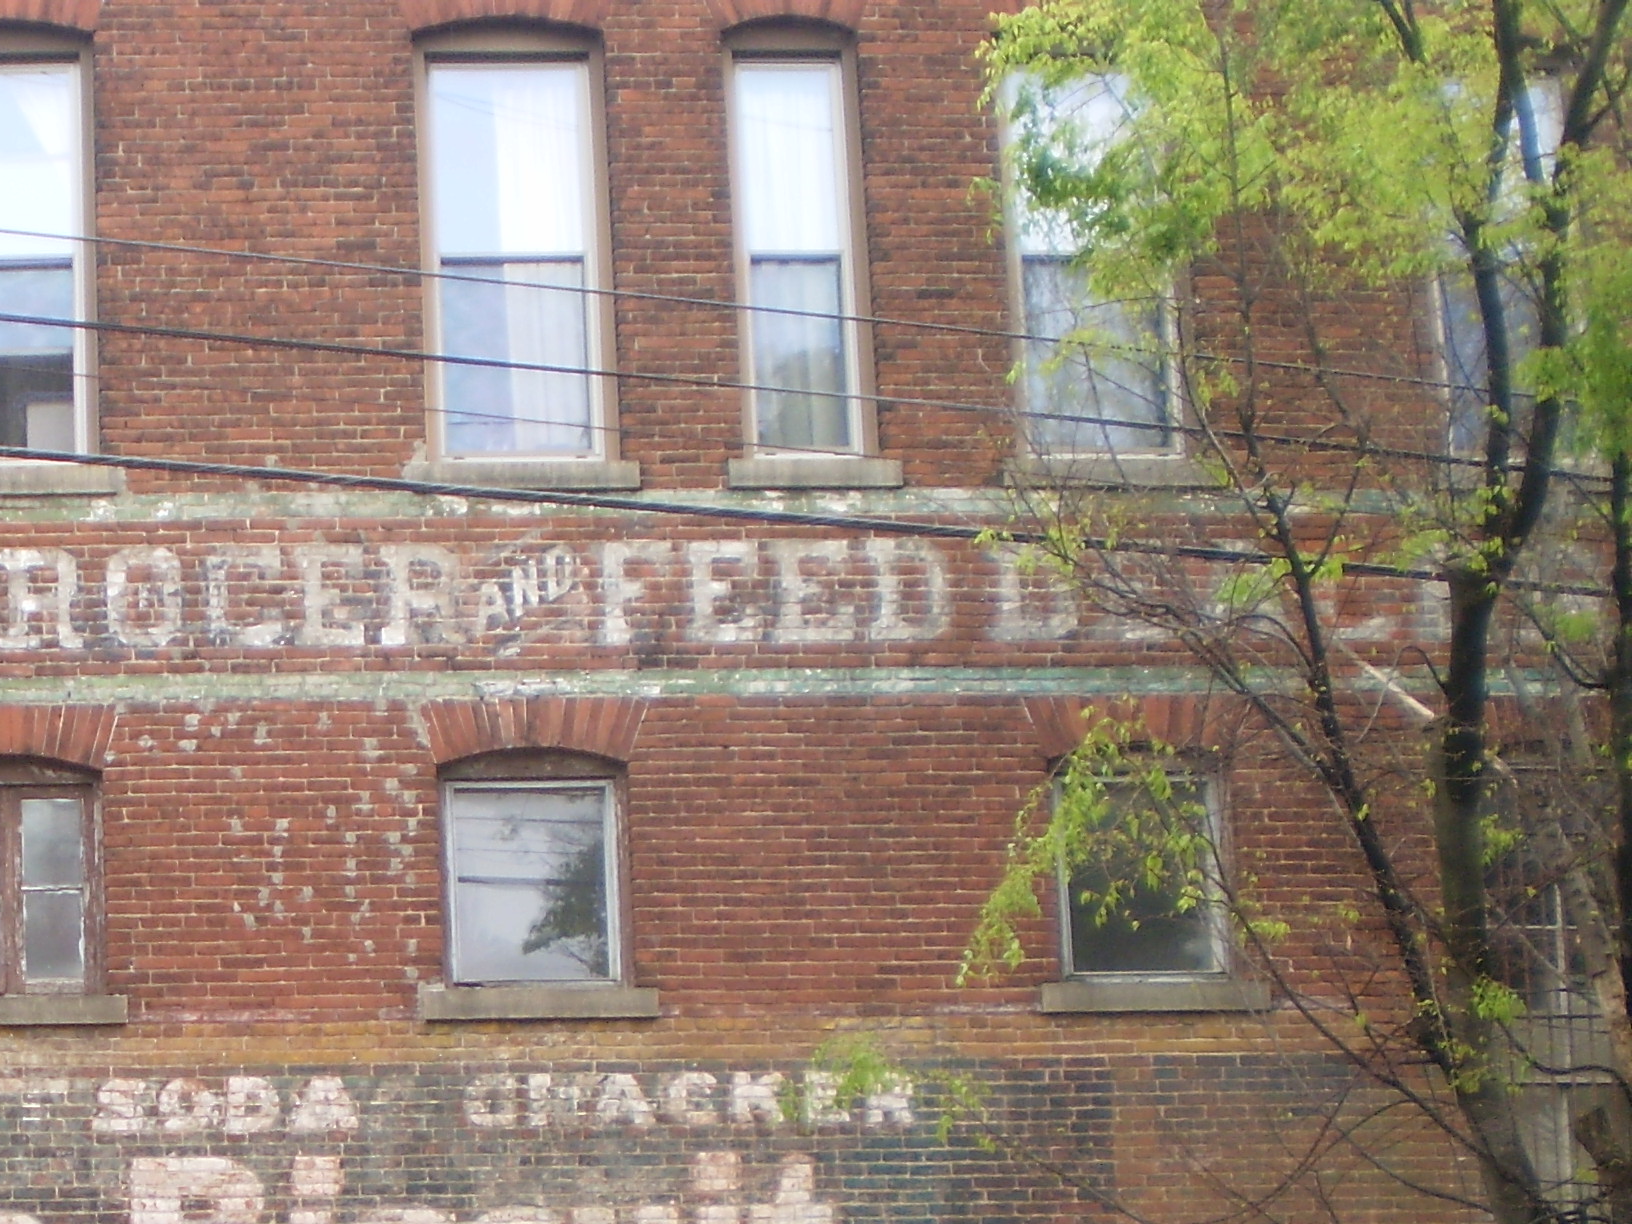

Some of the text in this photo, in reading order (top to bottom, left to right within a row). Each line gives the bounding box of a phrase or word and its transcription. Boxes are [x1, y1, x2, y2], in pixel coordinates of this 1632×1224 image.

[476, 545, 576, 632] AND
[598, 539, 949, 645] FEED
[92, 1075, 359, 1134] SODA
